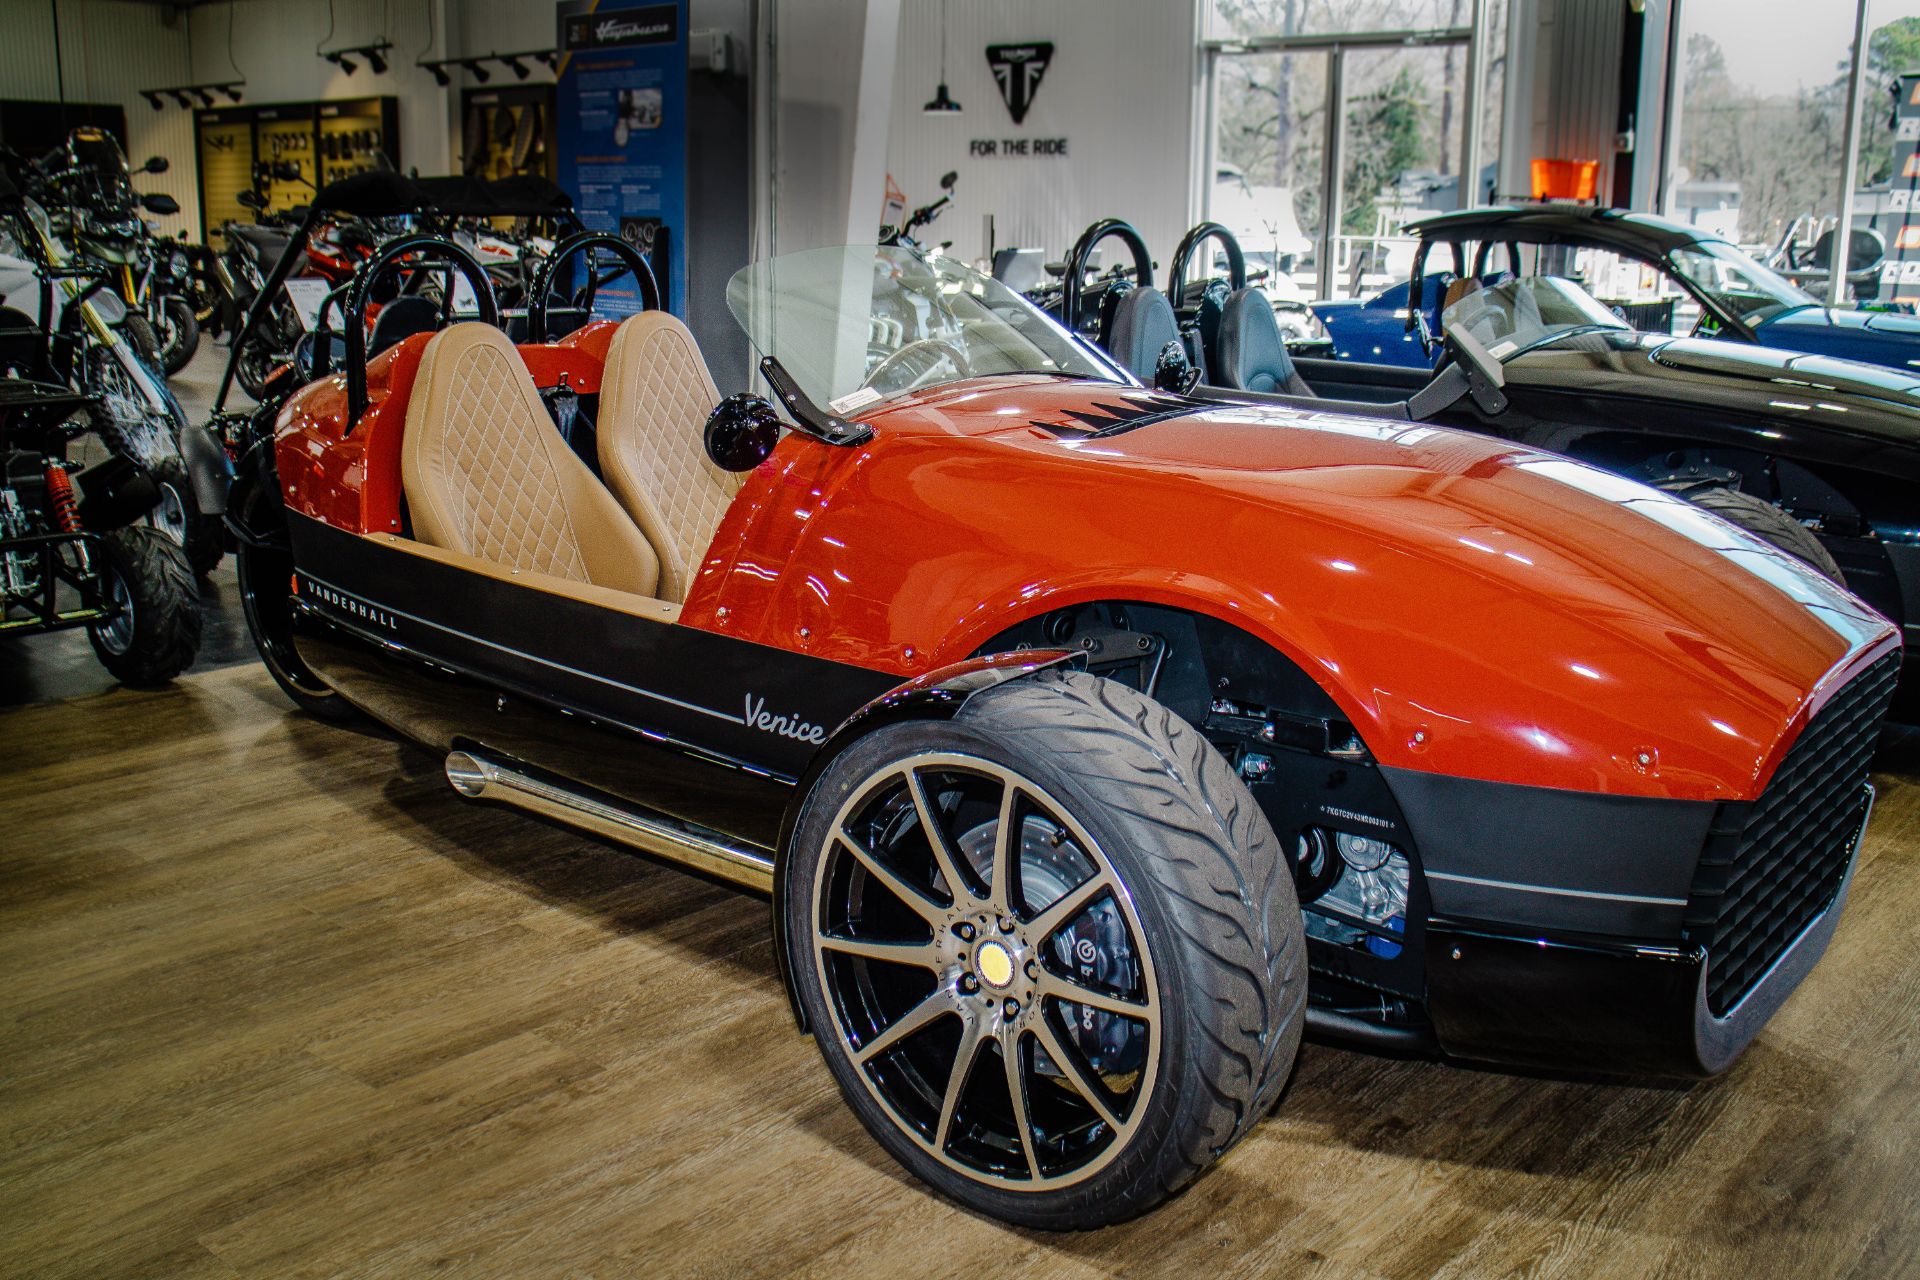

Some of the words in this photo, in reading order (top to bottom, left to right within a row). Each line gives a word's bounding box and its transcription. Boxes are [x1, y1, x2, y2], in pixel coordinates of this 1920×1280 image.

[969, 139, 998, 156] FOR
[1001, 139, 1029, 156] THE
[1033, 138, 1068, 156] RIDE
[308, 581, 397, 630] VANDERHALL
[745, 692, 827, 745] Venice
